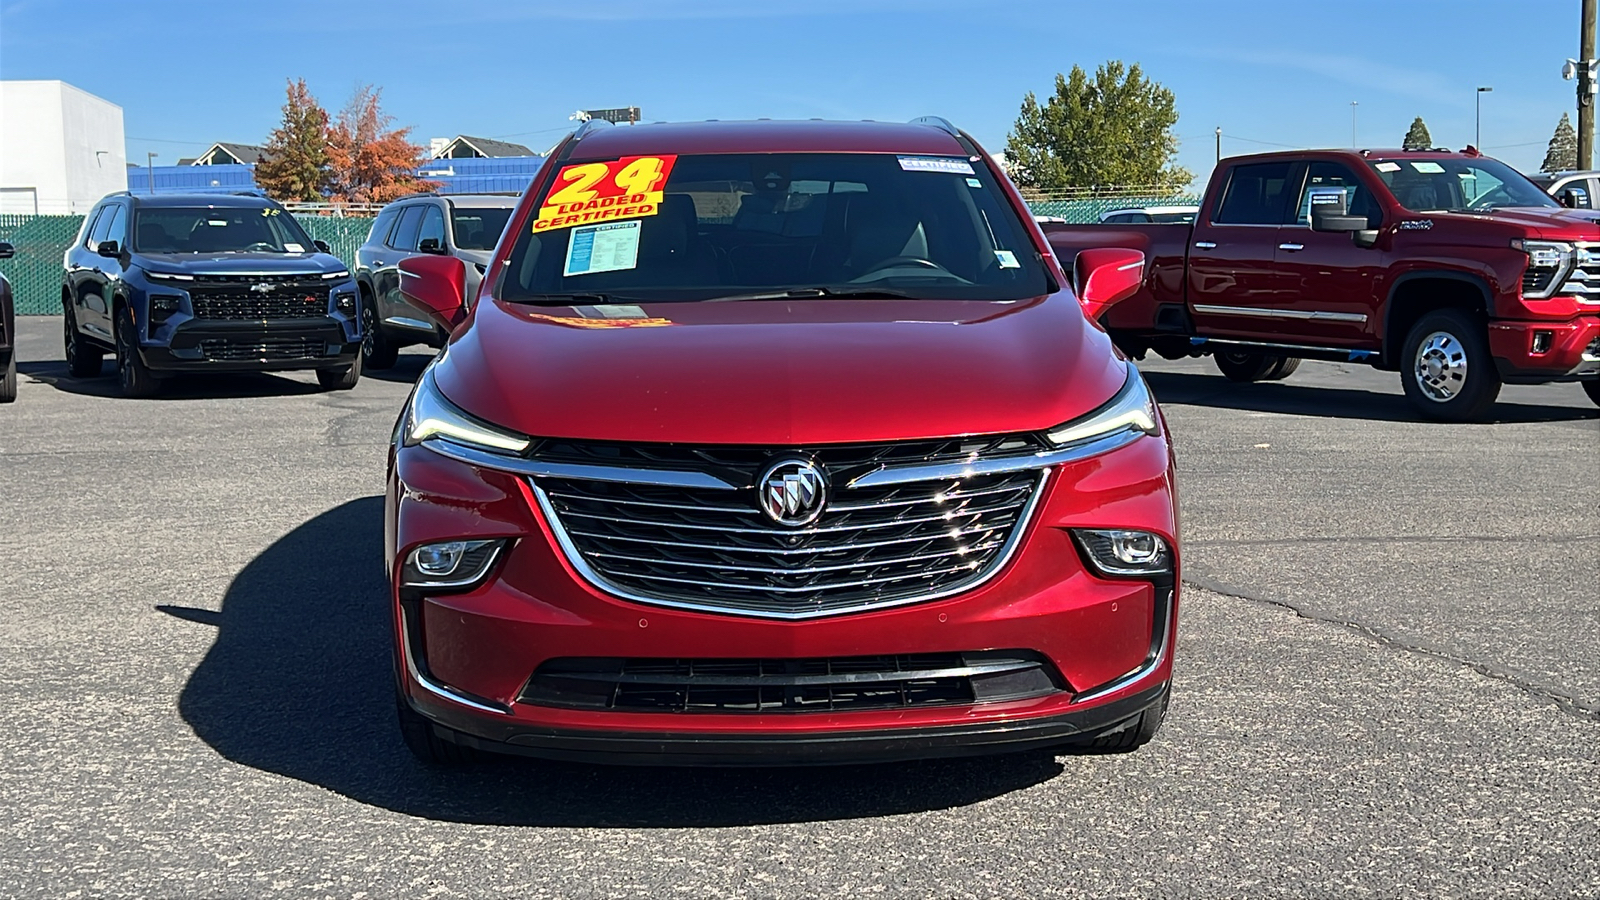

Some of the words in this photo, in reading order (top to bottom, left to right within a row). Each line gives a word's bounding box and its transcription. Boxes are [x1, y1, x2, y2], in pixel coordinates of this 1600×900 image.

[902, 160, 969, 169] CERTIFIED
[548, 157, 664, 205] 24
[557, 194, 647, 214] LOADED
[534, 205, 653, 229] CERTIFIED
[596, 223, 635, 231] CERTIFIED
